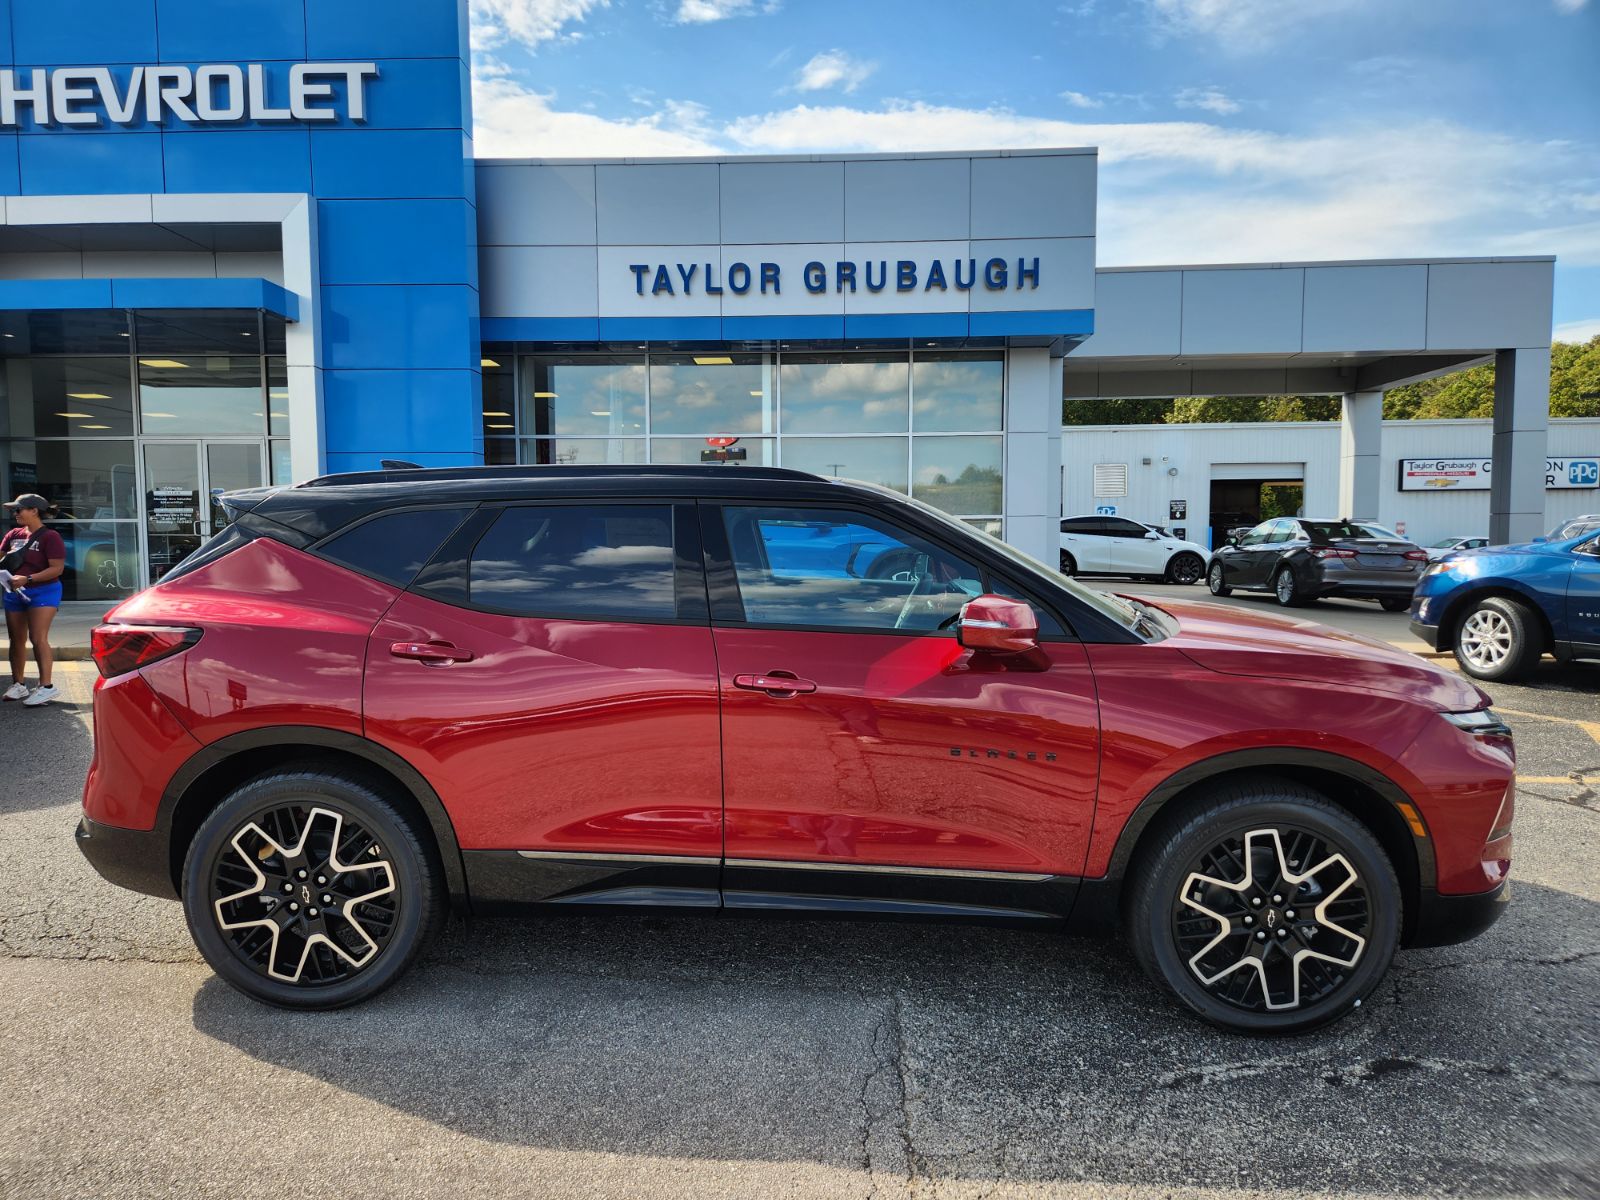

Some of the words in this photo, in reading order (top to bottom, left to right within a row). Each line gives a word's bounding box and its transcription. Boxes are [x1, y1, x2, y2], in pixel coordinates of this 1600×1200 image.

[629, 261, 782, 296] TAYLOR
[803, 256, 1041, 294] GRUBAUGH
[1408, 461, 1435, 471] Taylor
[1435, 461, 1477, 471] Grubaugh
[1569, 463, 1597, 483] PPG
